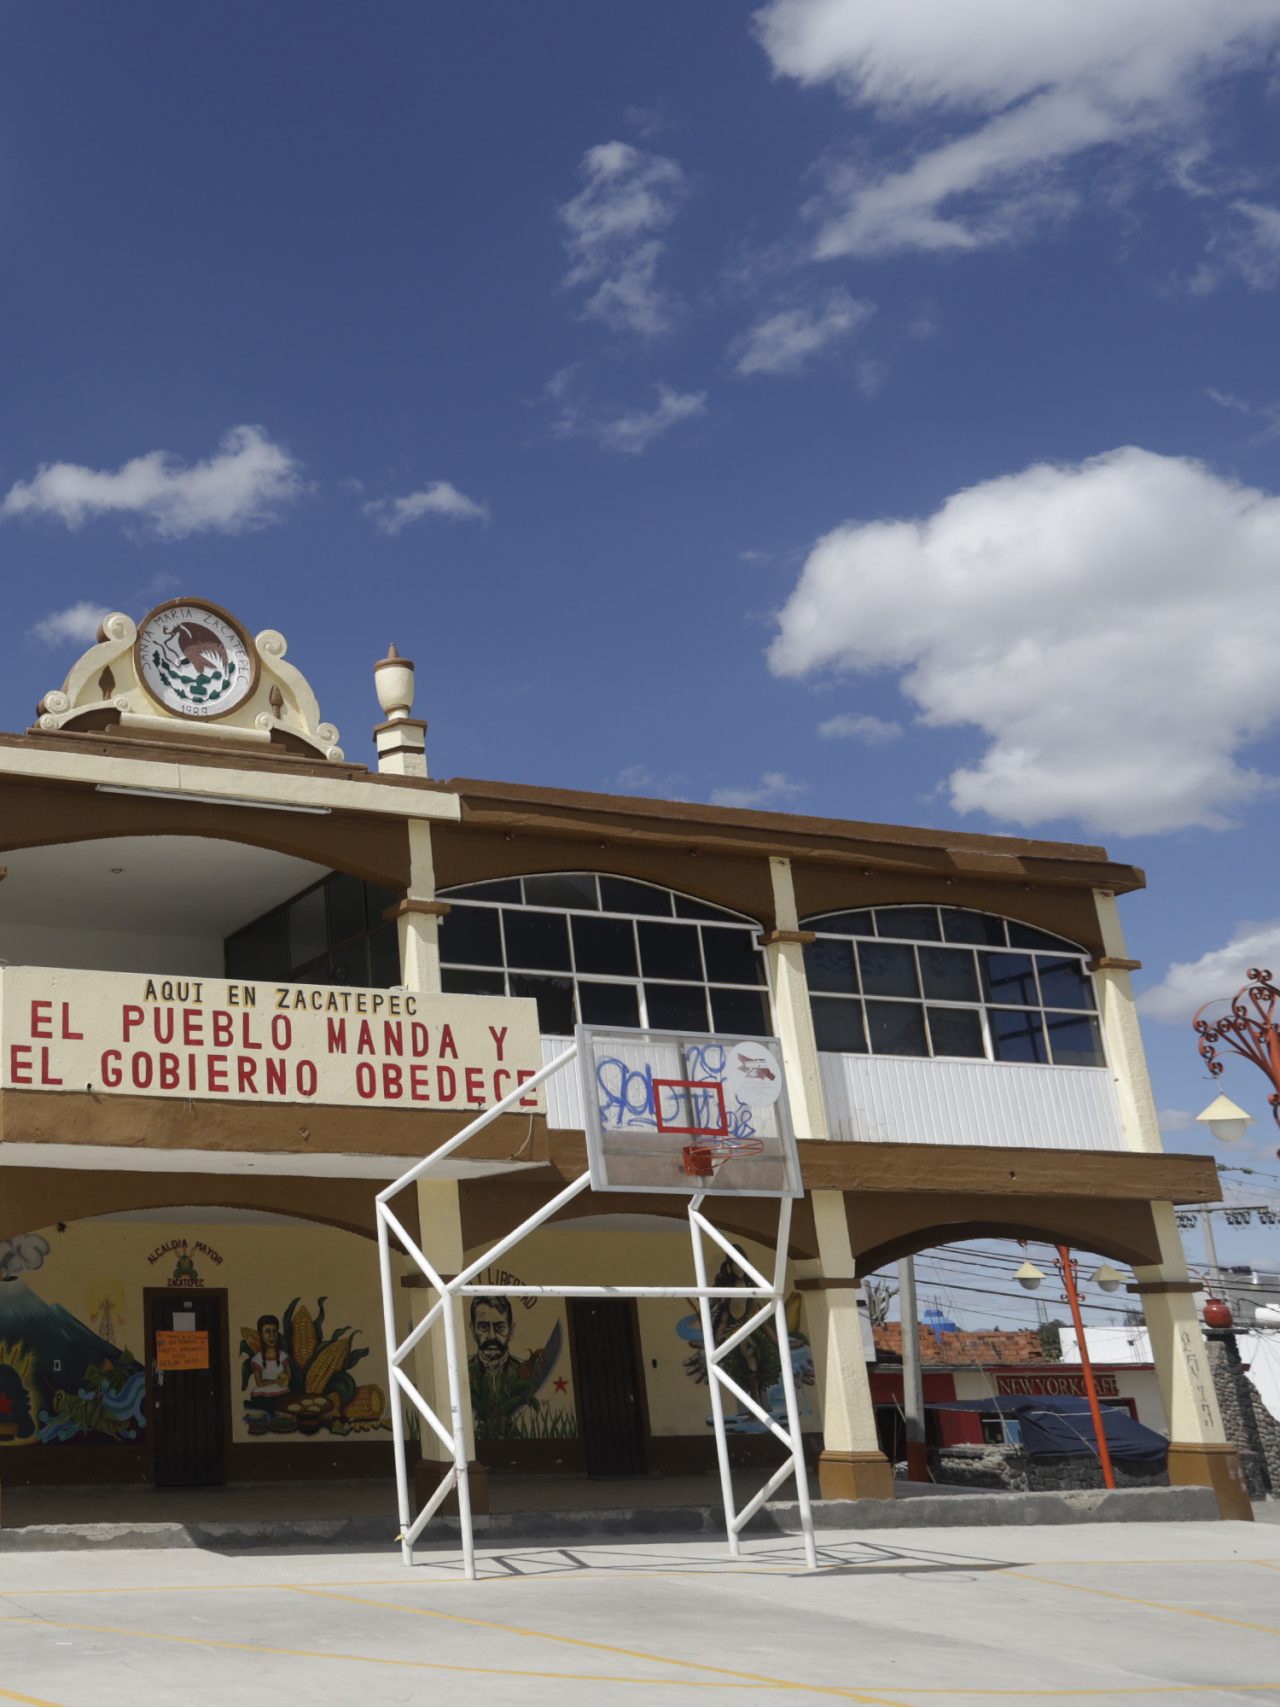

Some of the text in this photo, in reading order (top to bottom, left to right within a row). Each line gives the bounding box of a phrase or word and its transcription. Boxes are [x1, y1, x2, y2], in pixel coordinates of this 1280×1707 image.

[154, 608, 193, 627] MARIA
[203, 613, 249, 685] ZACATEPEC
[144, 979, 418, 1017] AQUI EN ZACATEPEC
[30, 1000, 509, 1062] EL PUEBLO MANDA Y
[10, 1044, 538, 1107] EL GOBIERNO OBEDECE
[147, 1238, 224, 1265] ALCALDIA MAYOR
[167, 1278, 205, 1287] ZACATEPEC
[998, 1378, 1033, 1396] NEW
[1035, 1377, 1081, 1396] YORK
